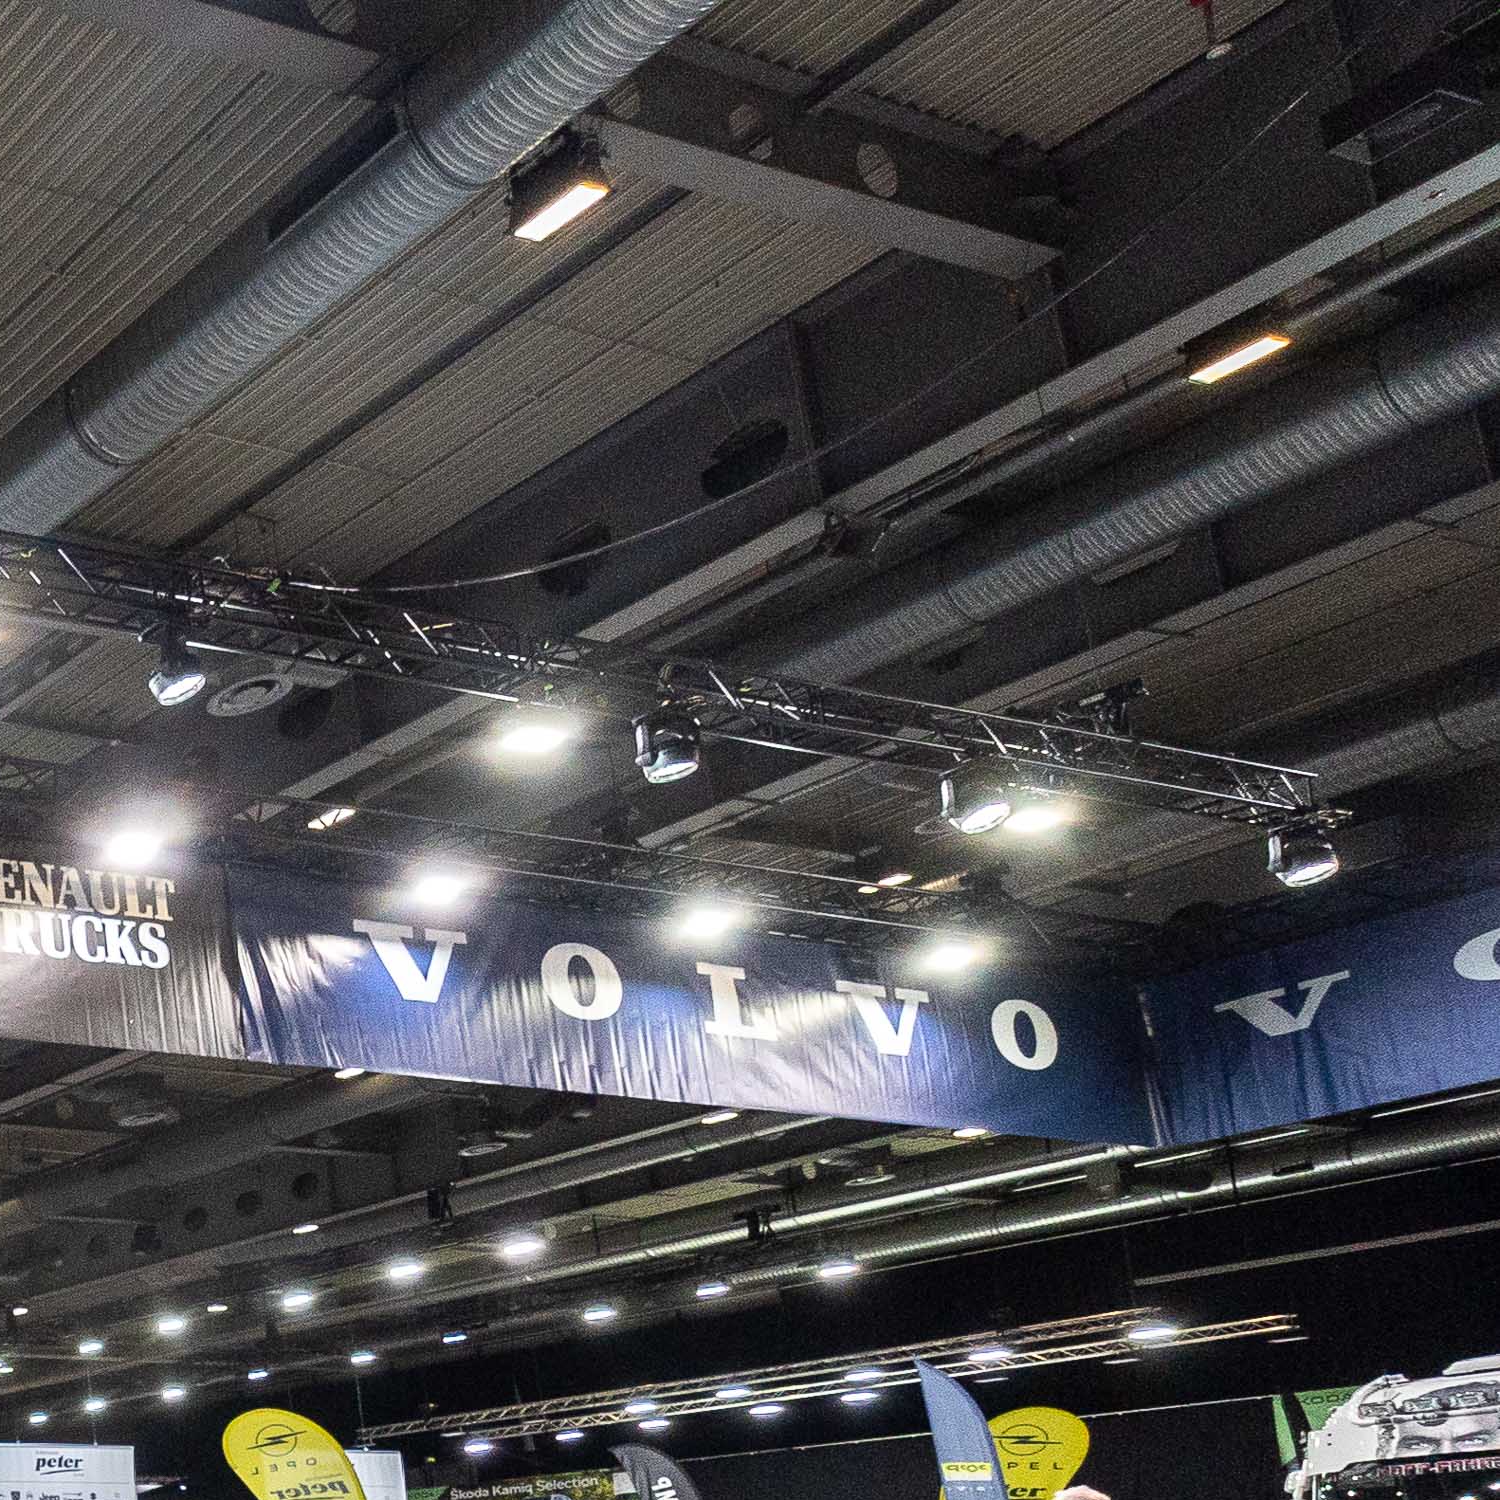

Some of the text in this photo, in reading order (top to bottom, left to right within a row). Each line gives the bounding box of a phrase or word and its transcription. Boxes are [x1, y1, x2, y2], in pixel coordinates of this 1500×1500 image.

[353, 918, 1059, 1071] VOLVO
[35, 1455, 83, 1471] peter
[1007, 1462, 1064, 1471] PEL
[450, 1476, 600, 1500] Škoda Kamiq Selection
